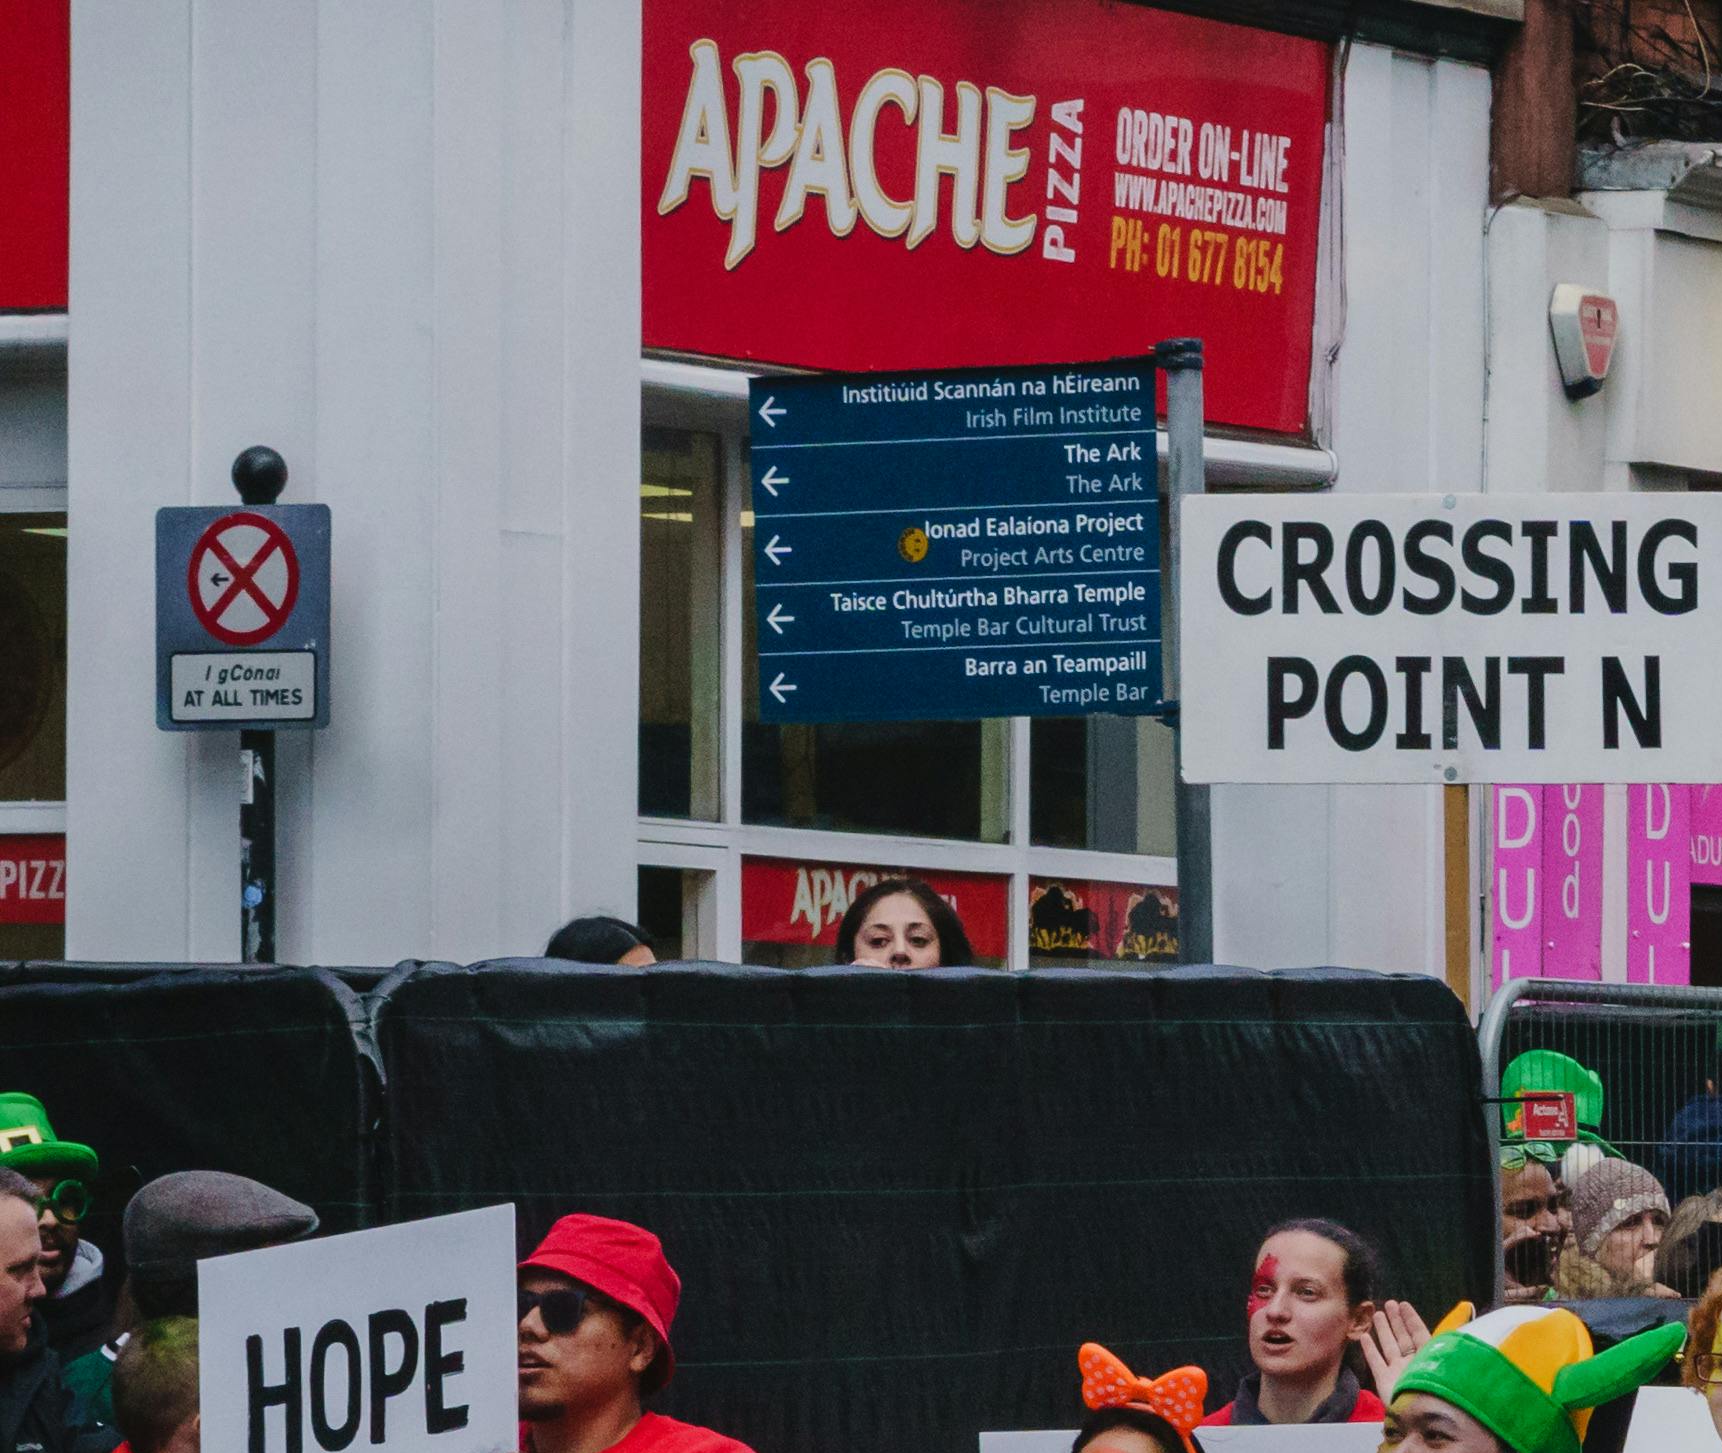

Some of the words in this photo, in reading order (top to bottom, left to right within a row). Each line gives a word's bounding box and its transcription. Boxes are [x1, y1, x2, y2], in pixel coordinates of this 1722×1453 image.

[657, 37, 1038, 271] APACHE
[1115, 106, 1193, 176] ORDER
[1198, 121, 1291, 193] ON-LINE
[1043, 98, 1085, 263] PIZZA
[1114, 172, 1288, 235] WWW.APACHEPIZZA.COM
[1110, 216, 1149, 272] PH:
[1156, 223, 1181, 279] 01
[1188, 228, 1229, 285] 677
[1233, 236, 1284, 294] 8154
[843, 382, 927, 404] Institiúid
[934, 378, 1014, 400] Scannán
[1022, 379, 1046, 396] na
[1053, 372, 1140, 395] hÉireann
[966, 409, 1006, 428] Irish
[1013, 406, 1053, 426] Film
[1060, 403, 1142, 425] Institute
[1064, 443, 1101, 464] The
[1107, 441, 1142, 462] Ark
[1066, 474, 1102, 494] The
[1108, 472, 1143, 493] Ark
[925, 517, 979, 539] Ionad
[987, 515, 1069, 537] Ealaíona
[1076, 511, 1144, 537] Project
[961, 547, 1029, 572] Project
[1034, 546, 1074, 565] Arts
[1080, 543, 1145, 564] Centre
[1217, 518, 1698, 616] CROSSING
[830, 592, 887, 613] Taisce
[893, 587, 998, 610] Chultúrtha
[1004, 584, 1068, 606] Bharra
[1074, 581, 1145, 607] Temple
[901, 618, 971, 643] Temple
[978, 617, 1010, 637] Bar
[1016, 613, 1092, 636] Cultural
[1099, 612, 1147, 633] Trust
[965, 657, 1017, 678] Barra
[1023, 659, 1047, 674] an
[1053, 651, 1147, 677] Teampaill
[184, 690, 205, 707] AT
[211, 689, 243, 706] ALL
[250, 688, 303, 705] TIMES
[1039, 683, 1110, 706] Temple
[1116, 682, 1149, 702] Bar
[1267, 654, 1566, 752] POINT
[1601, 655, 1662, 749] N
[0, 860, 66, 899] PIZZ
